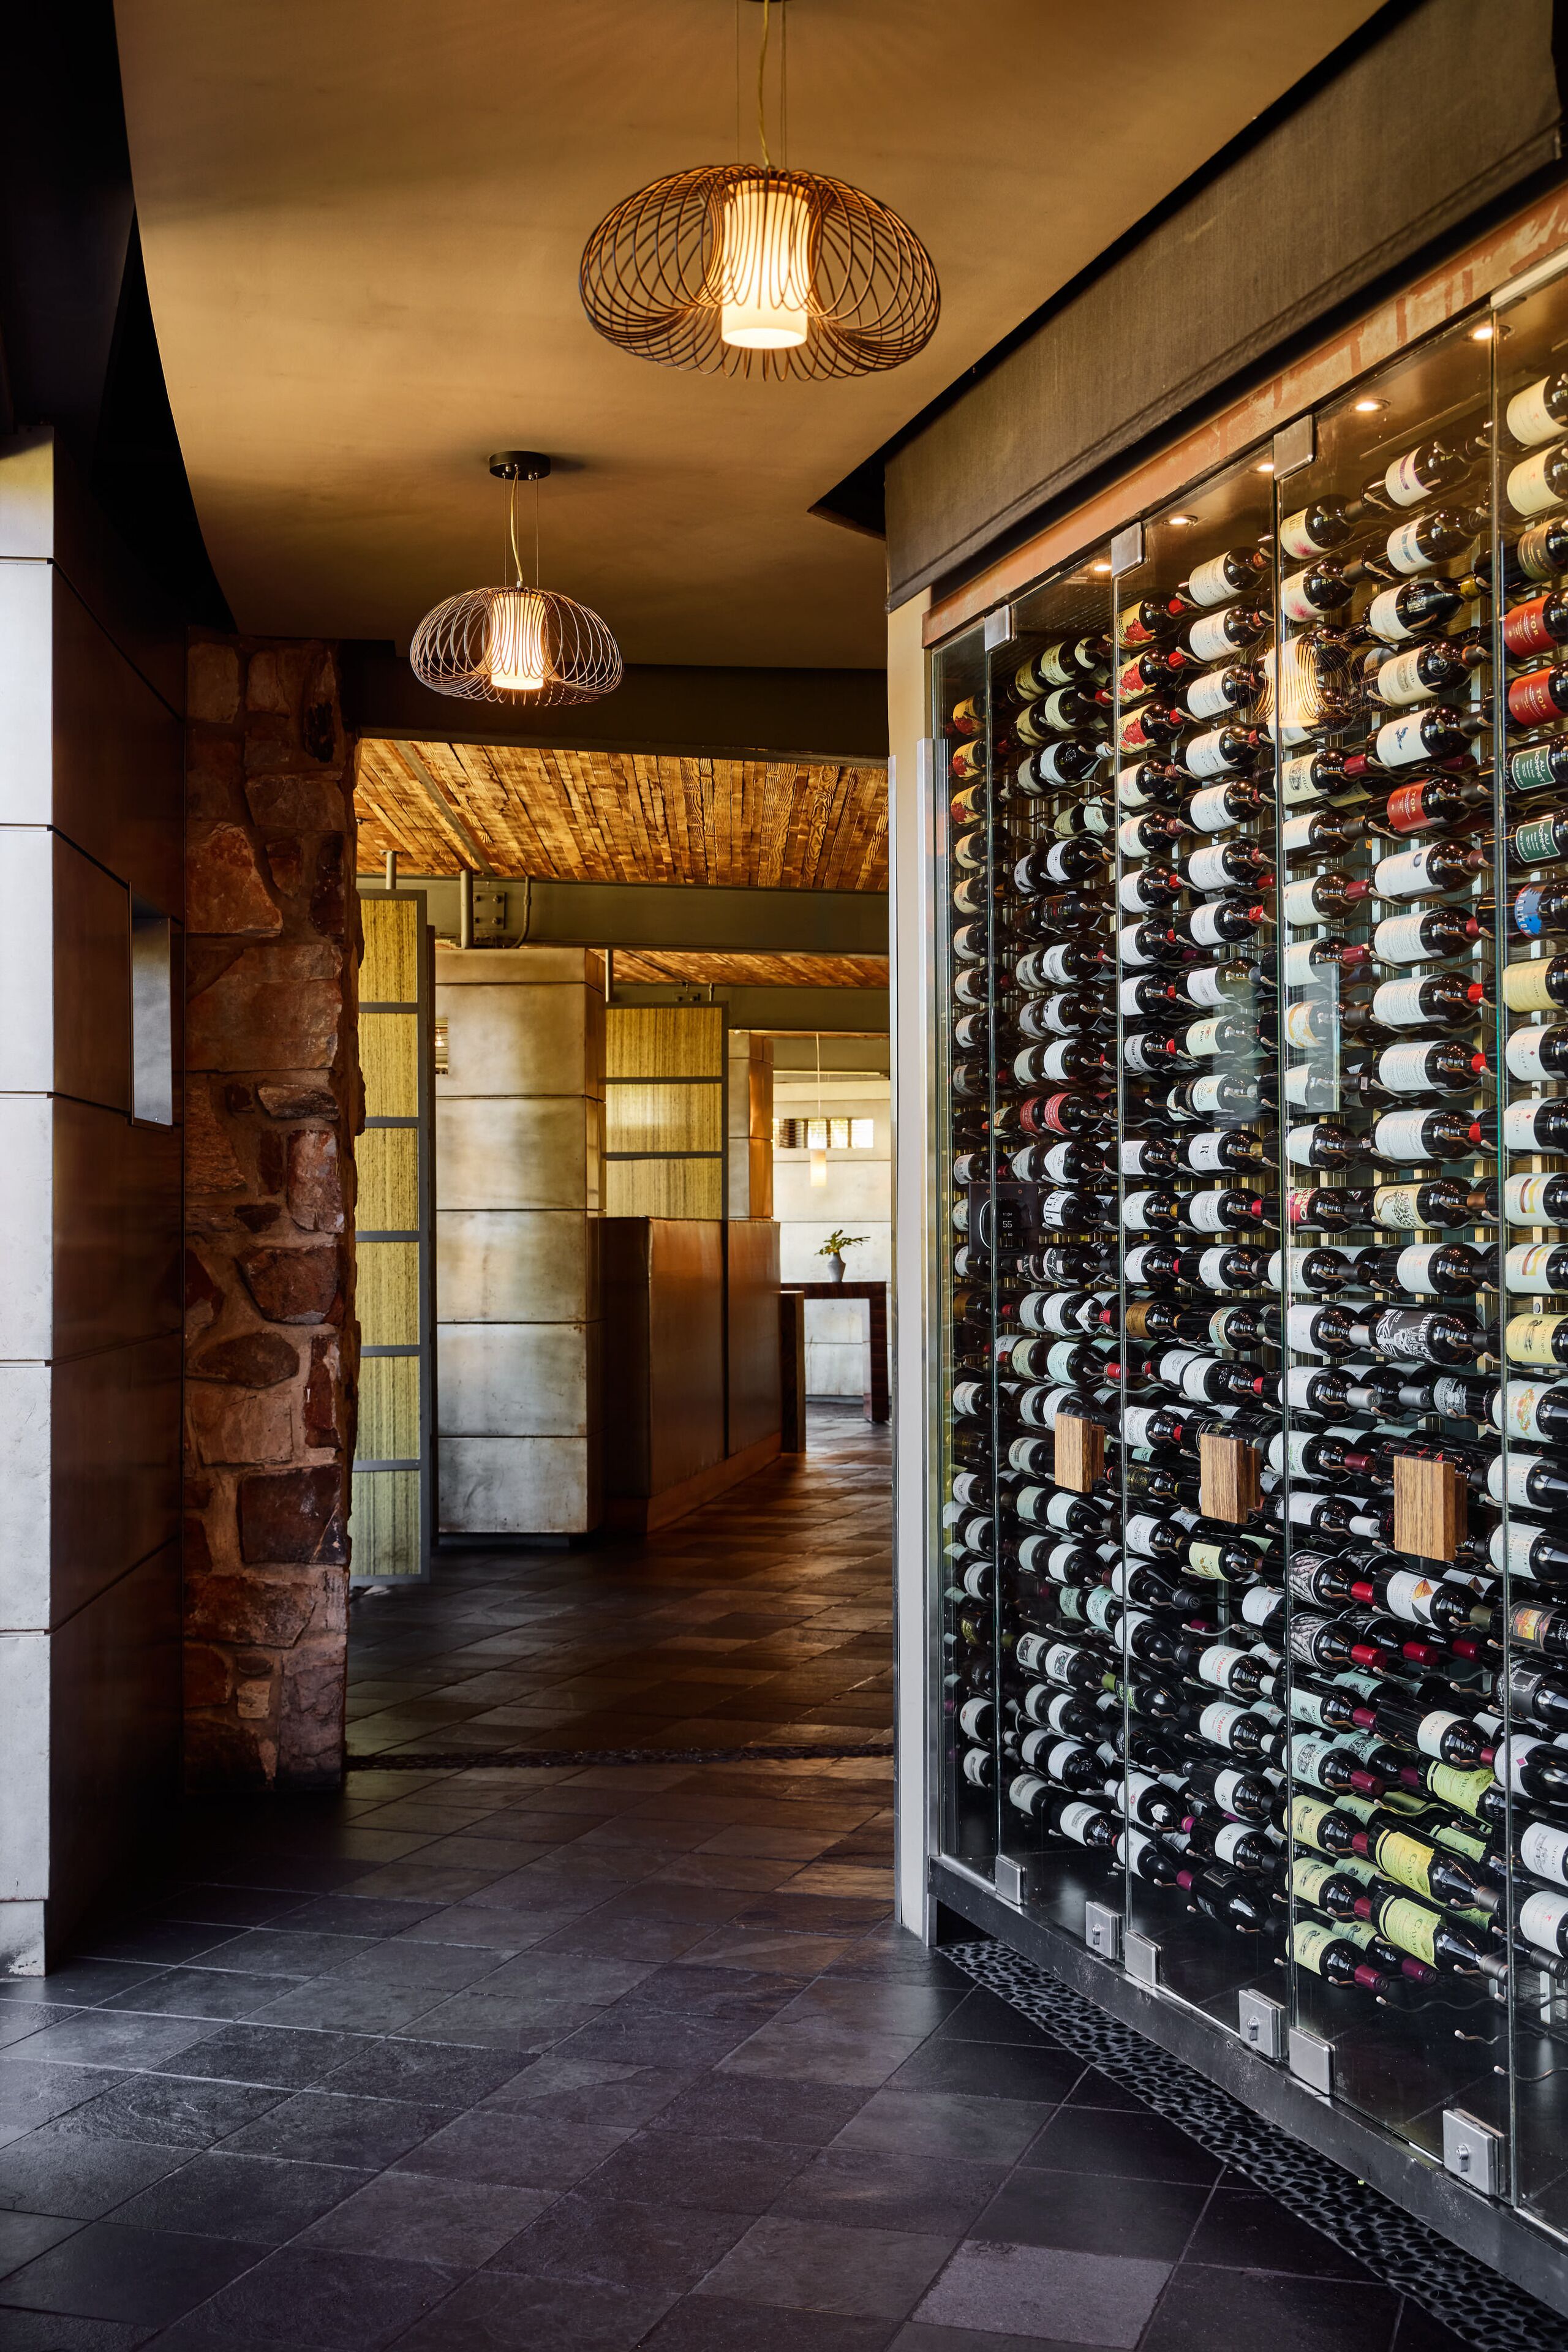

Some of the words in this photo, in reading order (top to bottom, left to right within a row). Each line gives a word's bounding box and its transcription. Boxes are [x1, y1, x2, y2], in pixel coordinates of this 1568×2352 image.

[1531, 613, 1539, 636] TOR
[1536, 688, 1547, 710] TOR
[1534, 749, 1545, 783] SOMMET
[1539, 760, 1546, 772] AU
[1539, 823, 1551, 856] SOMMET
[1544, 833, 1551, 845] AU
[1517, 893, 1532, 933] RADIKON
[1199, 1145, 1210, 1155] R
[1216, 1657, 1226, 1683] PARADE
[1216, 1716, 1226, 1742] PARADE
